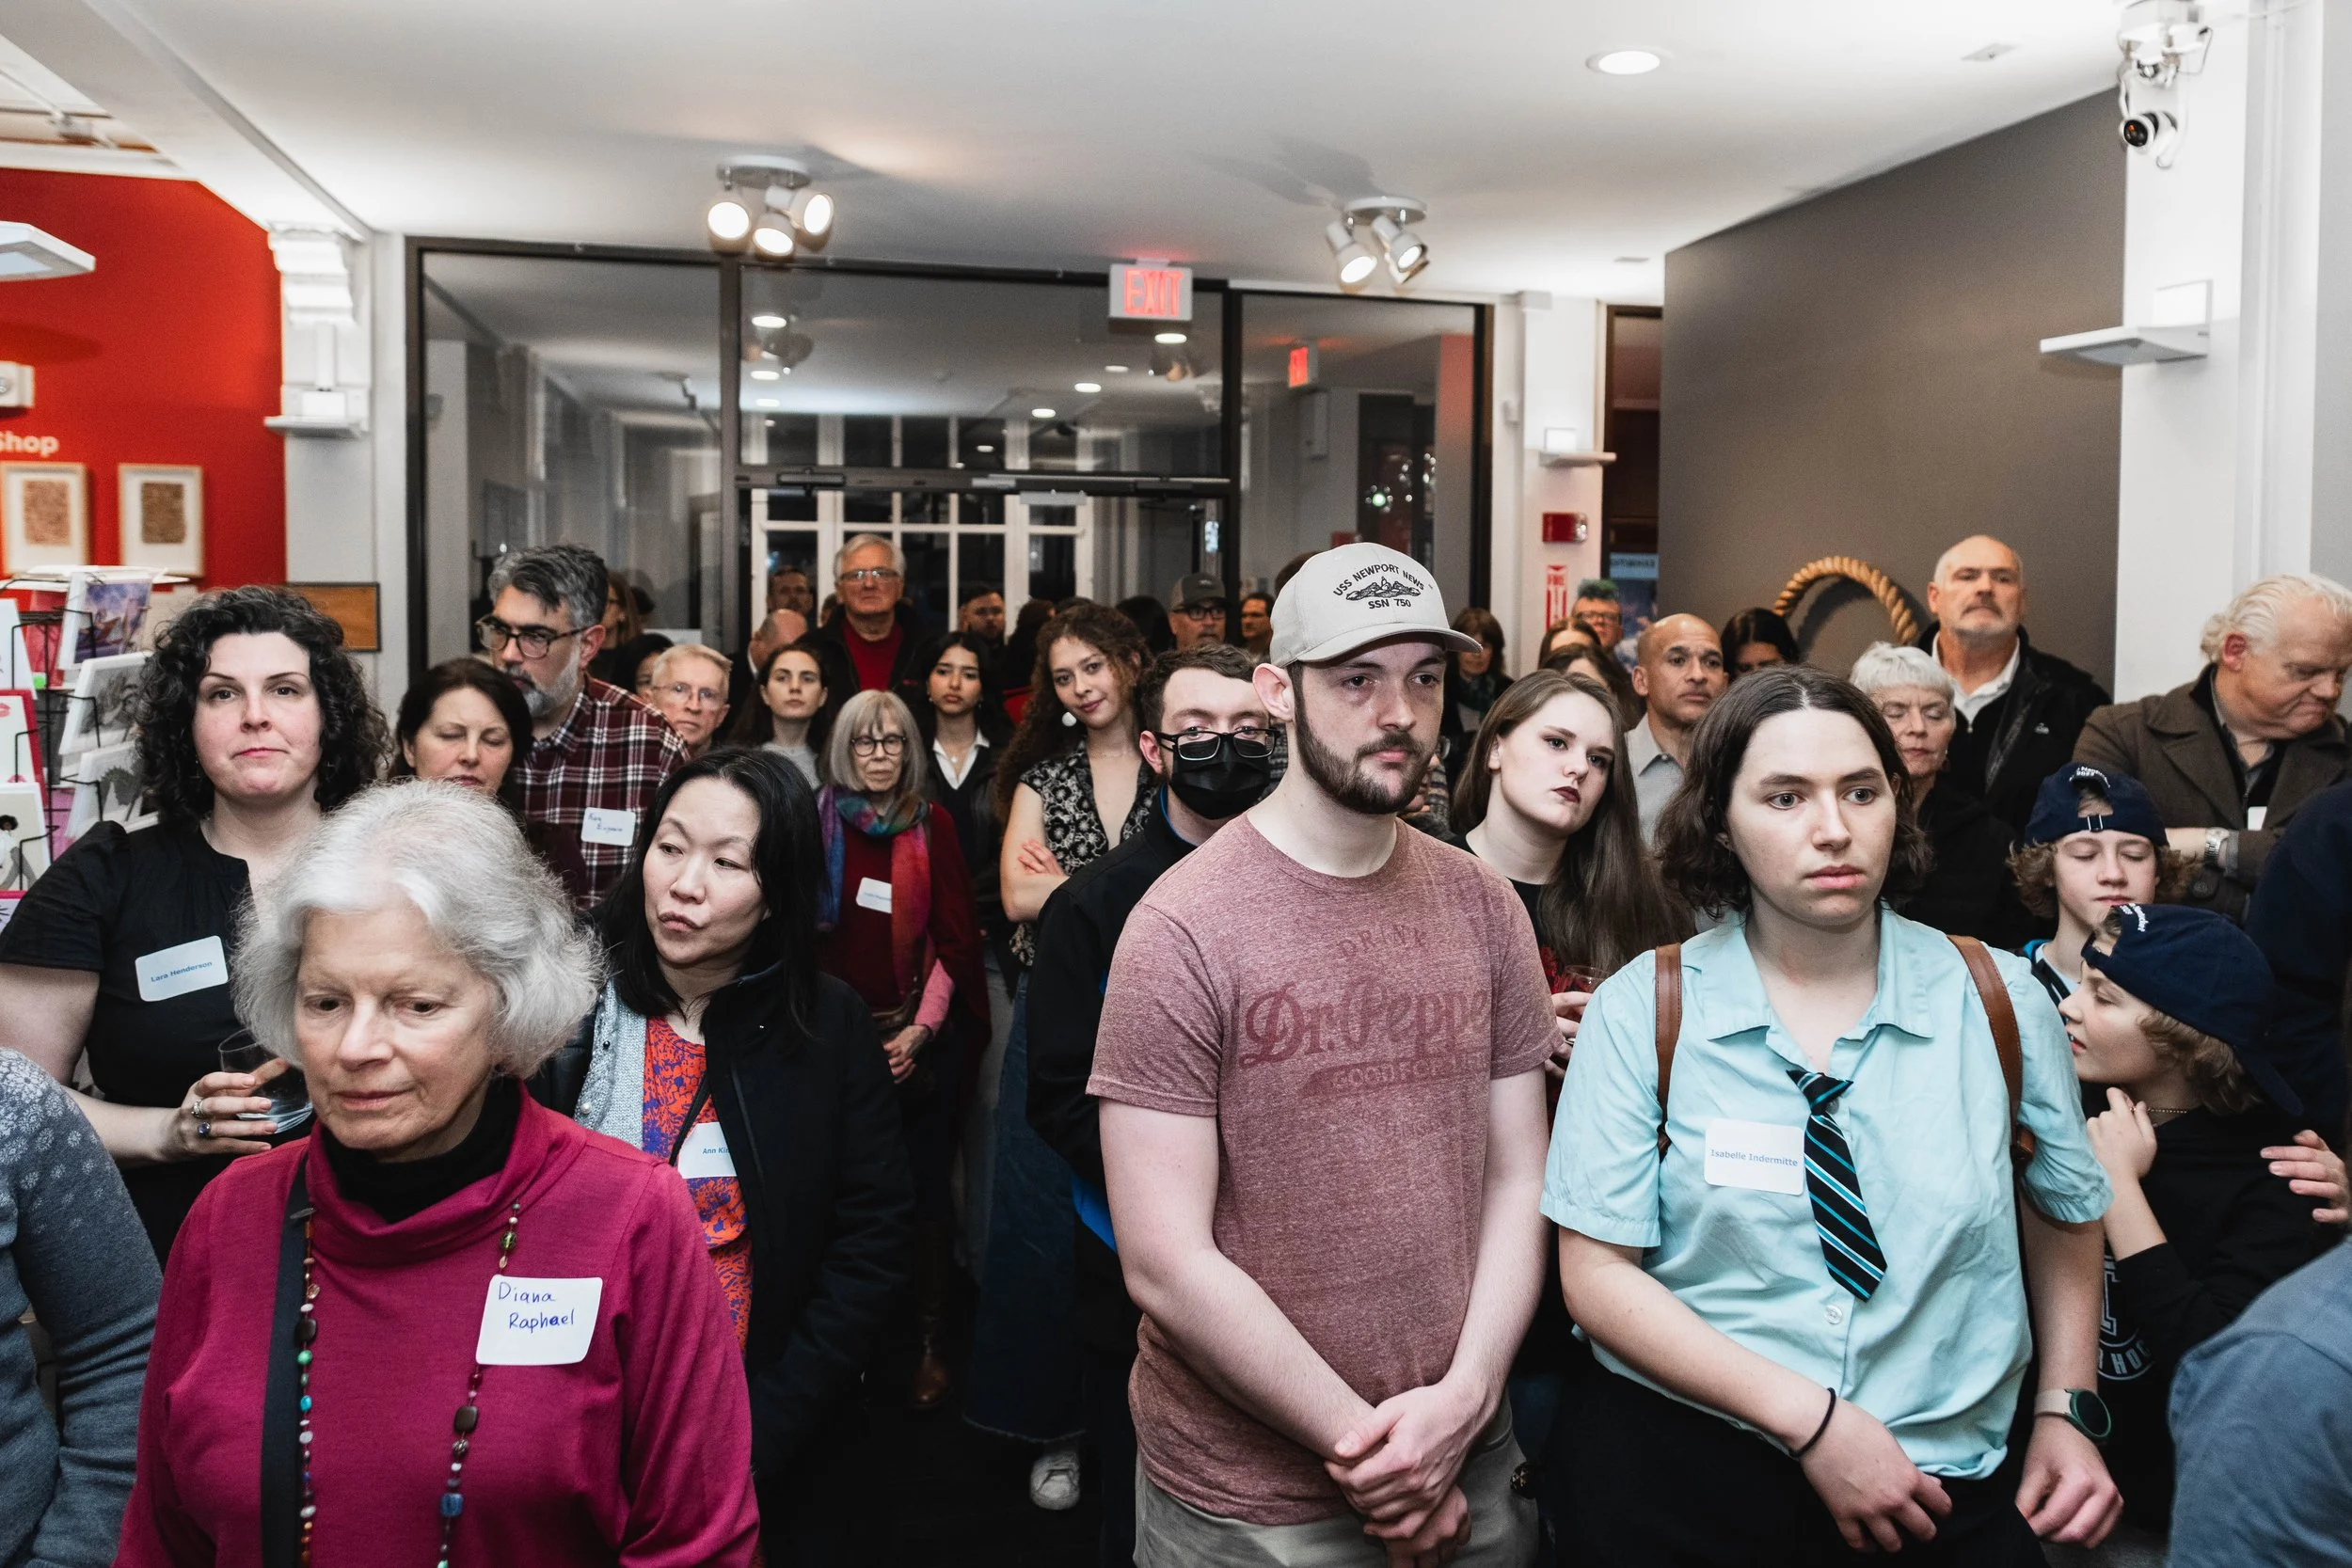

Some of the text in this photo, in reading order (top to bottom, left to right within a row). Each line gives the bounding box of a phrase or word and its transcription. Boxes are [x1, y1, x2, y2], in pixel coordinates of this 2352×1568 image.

[1124, 268, 1184, 316] EXIT
[1333, 563, 1424, 596] USS NEWPORT NEWS
[1368, 598, 1411, 609] SSN 750
[1339, 925, 1427, 958] DRINK
[151, 960, 213, 982] Lara Henderson
[1710, 1148, 1798, 1166] Isabelle Indermitte
[499, 1281, 557, 1304] Diana
[509, 1307, 575, 1333] Raphael
